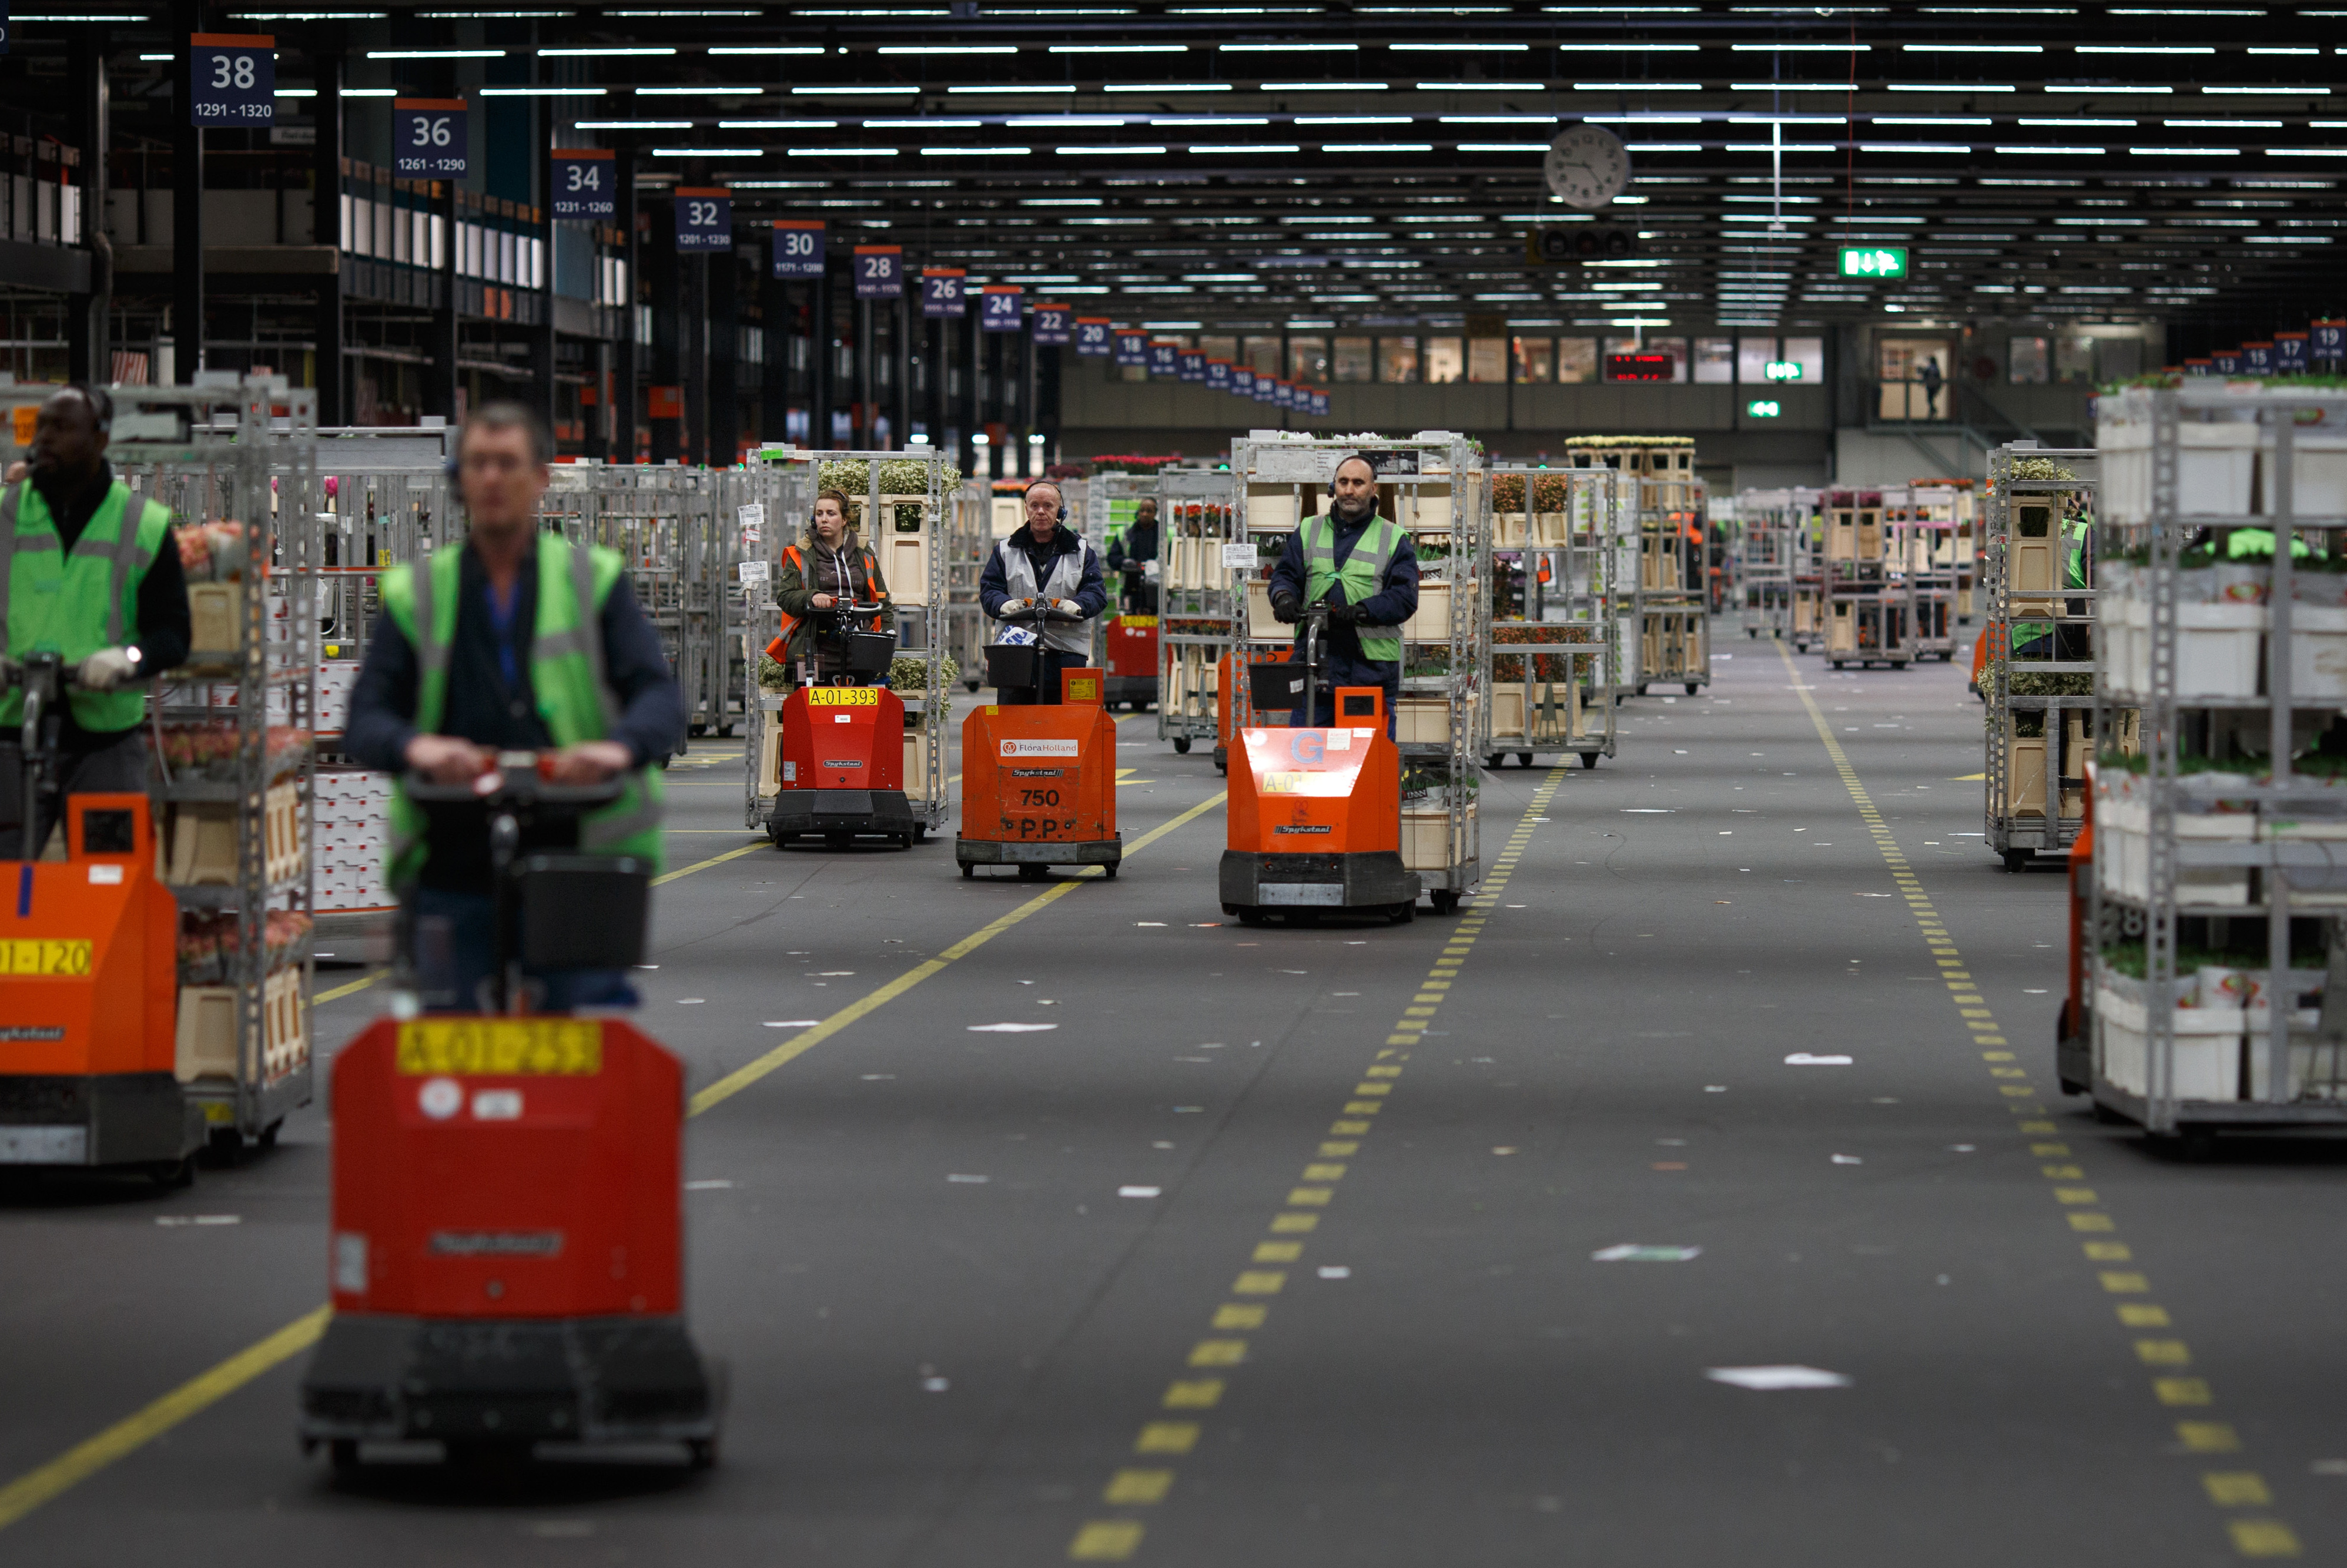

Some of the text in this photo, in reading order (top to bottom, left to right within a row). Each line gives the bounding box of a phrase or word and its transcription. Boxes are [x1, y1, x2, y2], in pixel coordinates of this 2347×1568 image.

[211, 55, 255, 89] 38
[196, 103, 227, 116] 1291
[239, 105, 272, 118] 1320
[412, 116, 451, 146] 36
[399, 158, 426, 170] 1261
[437, 159, 466, 170] 1290
[566, 165, 600, 192] 34
[554, 201, 580, 213] 1231
[588, 202, 613, 213] 1260
[688, 201, 718, 226] 32
[785, 233, 813, 256] 30
[865, 257, 892, 278] 28
[931, 279, 957, 299] 26
[990, 295, 1013, 314] 24
[1040, 312, 1062, 330] 22
[1083, 325, 1104, 342] 20
[2319, 329, 2339, 346] 19
[1122, 337, 1141, 353] 18
[2281, 340, 2301, 357] 17
[1155, 348, 1173, 363] 16
[811, 690, 876, 705] A-01-393
[1291, 731, 1323, 764] G
[1020, 789, 1059, 807] 750
[0, 942, 91, 974] 1-120
